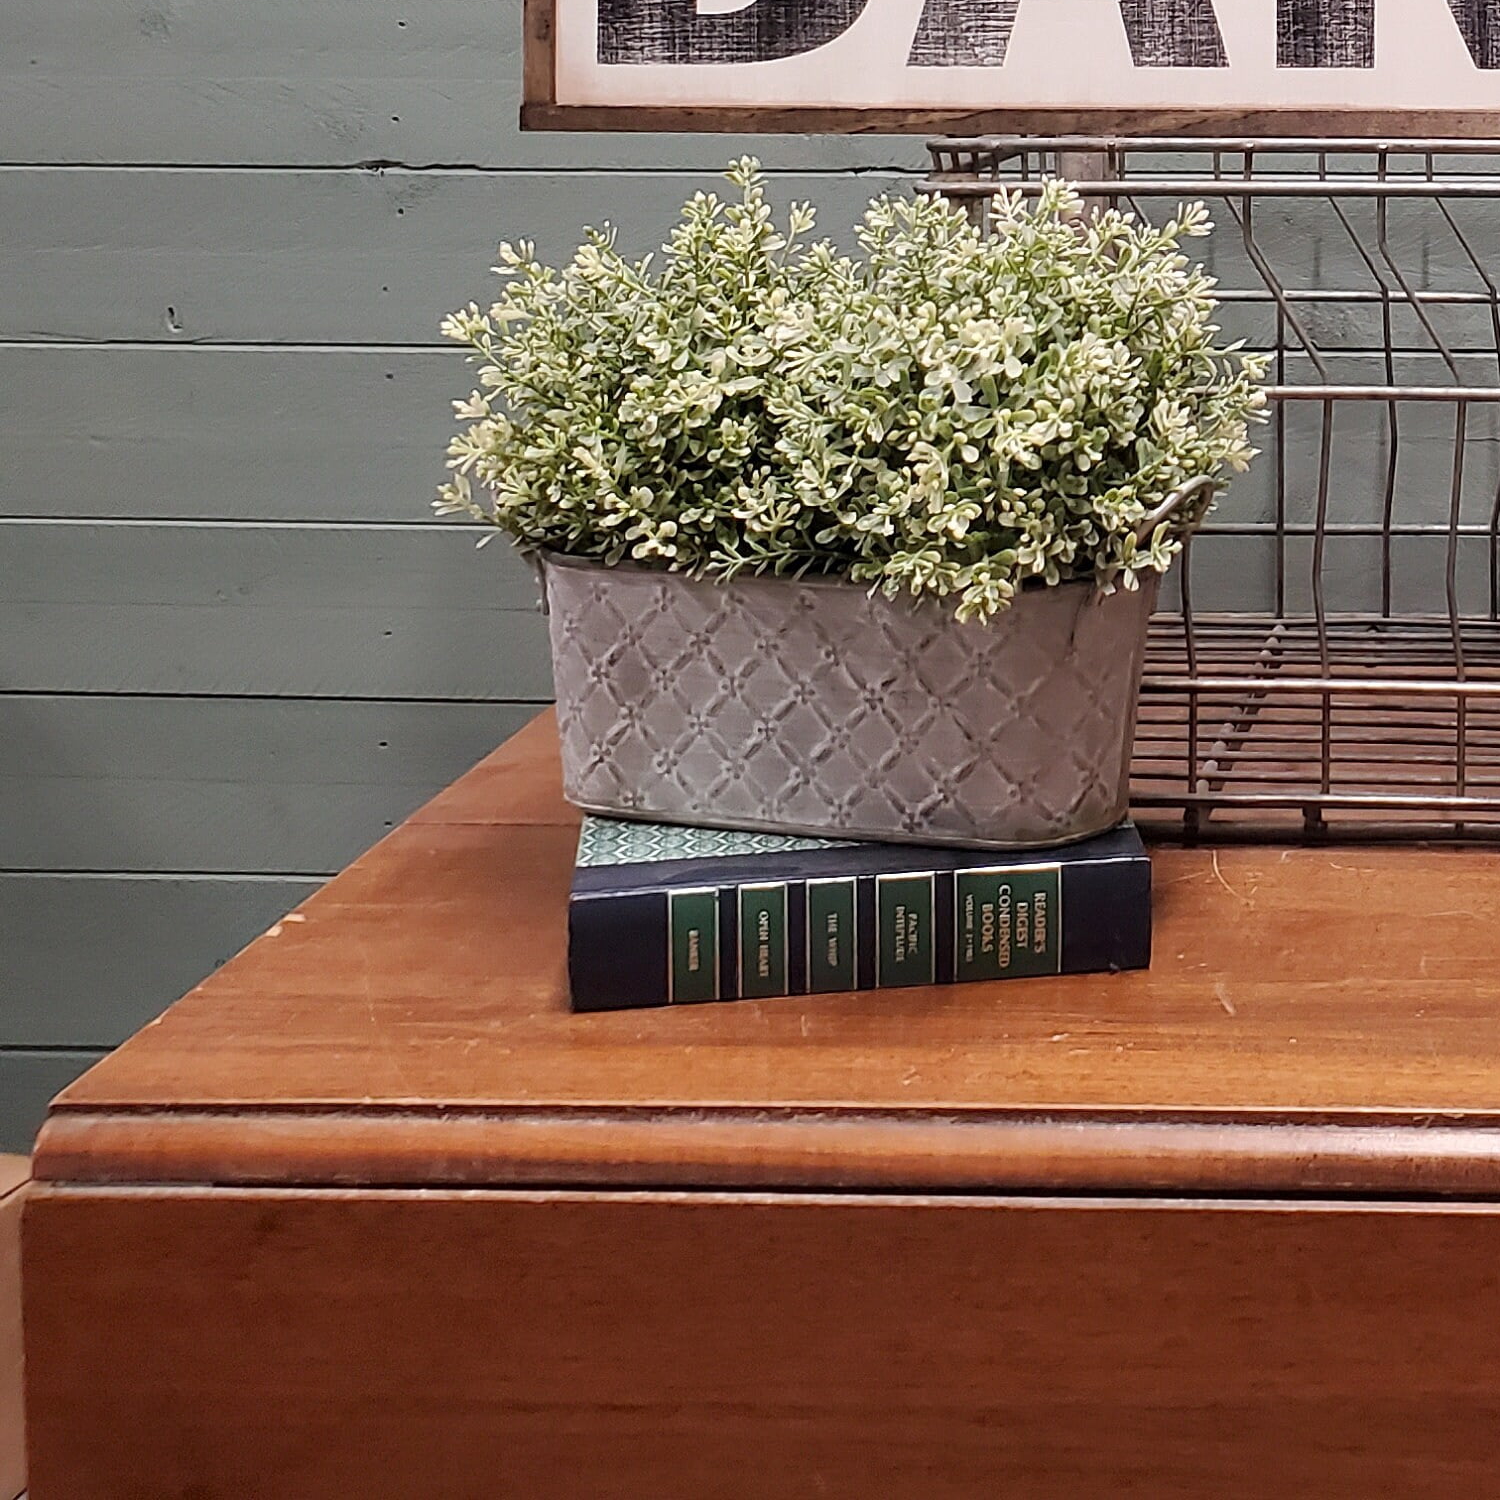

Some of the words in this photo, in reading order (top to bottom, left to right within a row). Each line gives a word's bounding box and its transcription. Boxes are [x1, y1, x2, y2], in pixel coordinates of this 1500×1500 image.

[758, 910, 769, 940] OPEN
[827, 912, 838, 933] THE
[981, 903, 994, 953] BOOKS
[998, 884, 1011, 968] CONDENSED
[1016, 902, 1029, 948] DIGEST
[1034, 892, 1047, 954] READER'S
[758, 944, 769, 977] HEART
